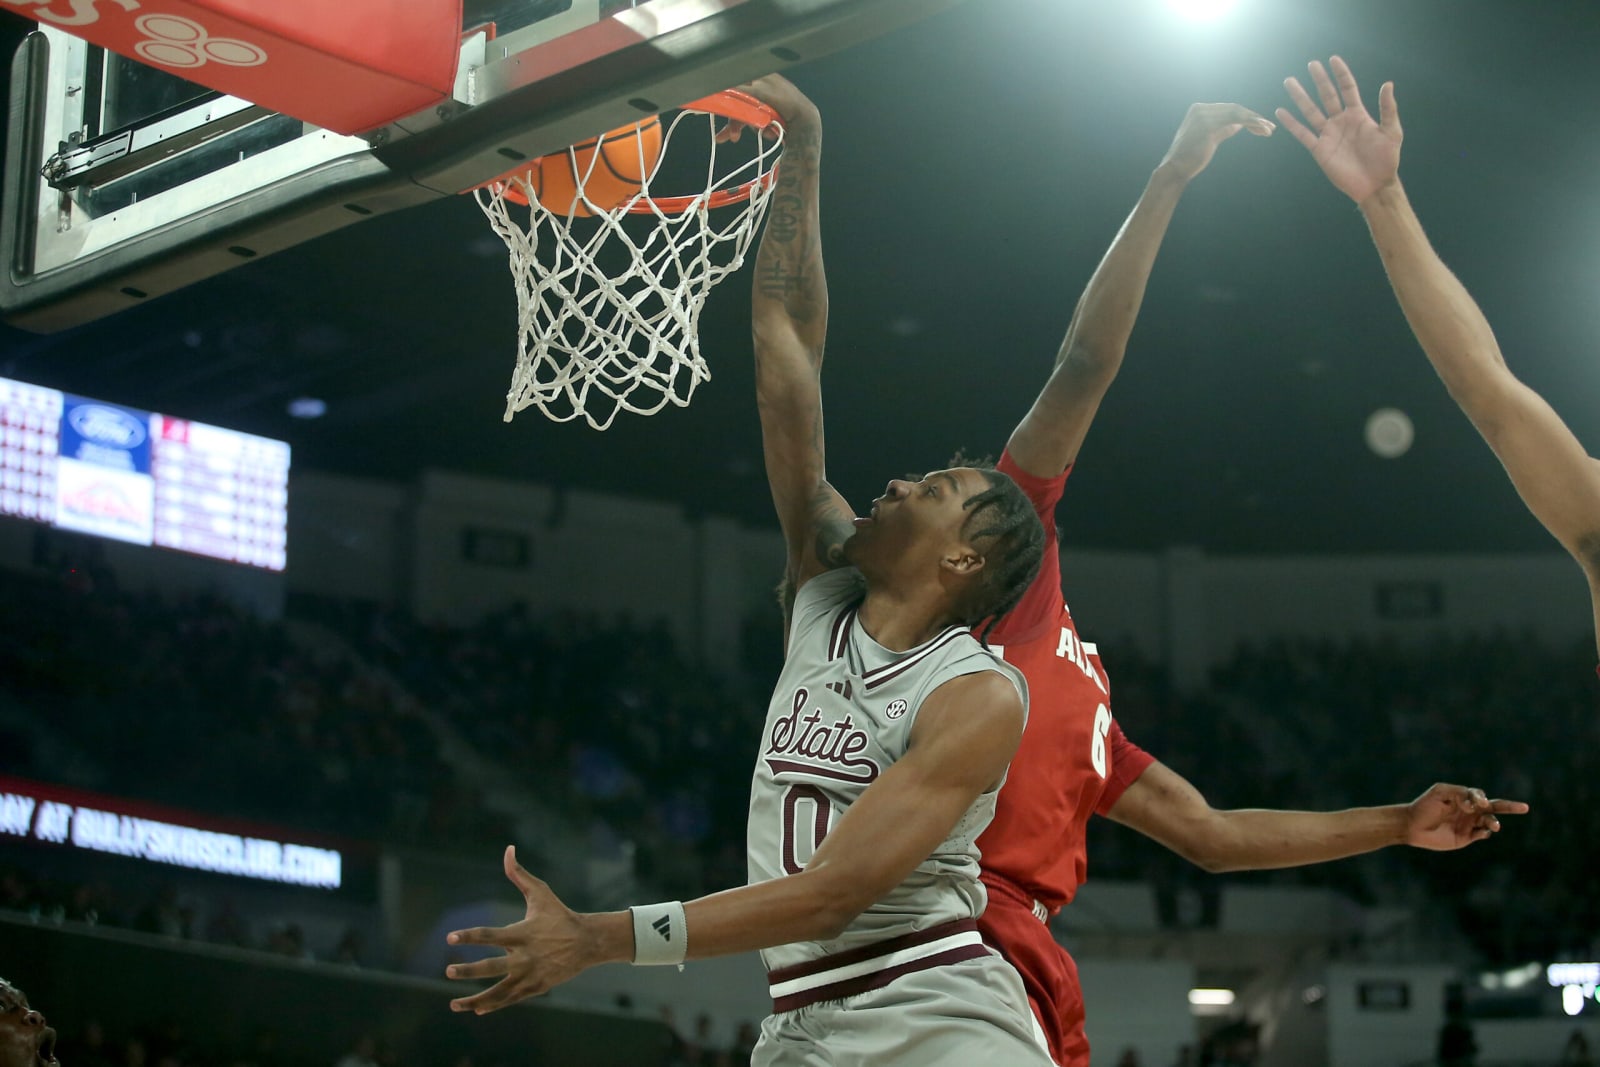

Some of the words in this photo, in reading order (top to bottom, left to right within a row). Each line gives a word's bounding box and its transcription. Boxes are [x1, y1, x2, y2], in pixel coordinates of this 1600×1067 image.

[763, 687, 878, 776] State
[36, 801, 73, 843] AT
[780, 784, 834, 876] 0
